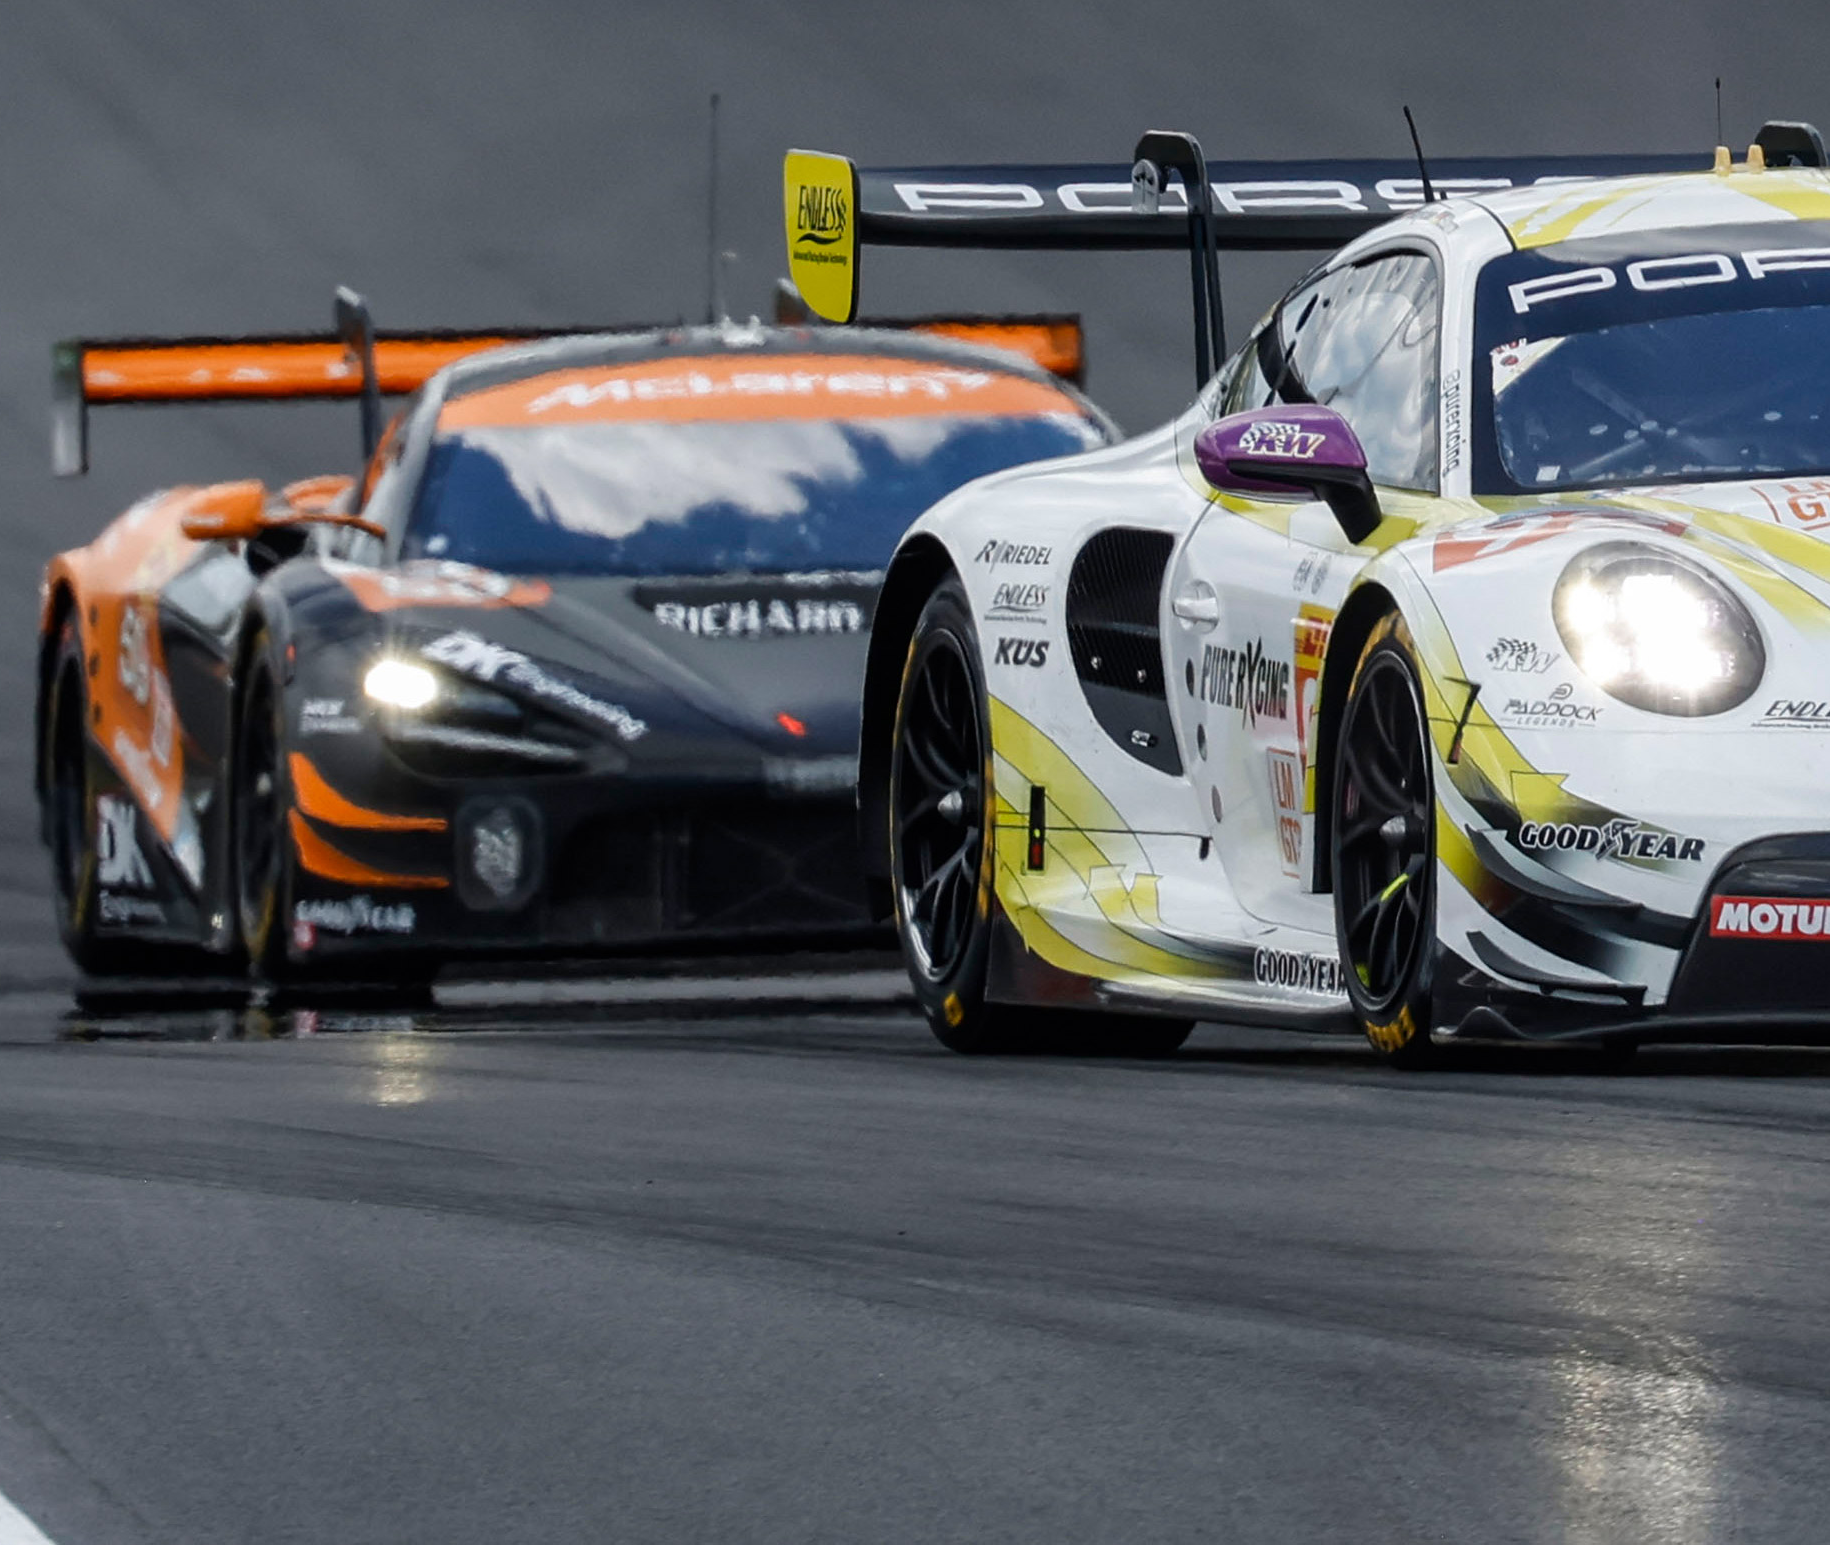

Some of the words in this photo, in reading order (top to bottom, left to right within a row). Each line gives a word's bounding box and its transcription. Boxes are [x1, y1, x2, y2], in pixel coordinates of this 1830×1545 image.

[797, 185, 847, 232] ENDLESS
[893, 180, 1594, 213] PORS
[1247, 428, 1326, 458] KW
[992, 583, 1050, 606] ENDLESS
[655, 599, 863, 637] RICHARD
[1201, 643, 1236, 708] PURE
[1235, 636, 1290, 730] RXCING
[1504, 699, 1604, 721] PADDOCK
[1521, 820, 1706, 861] GOODYEAR
